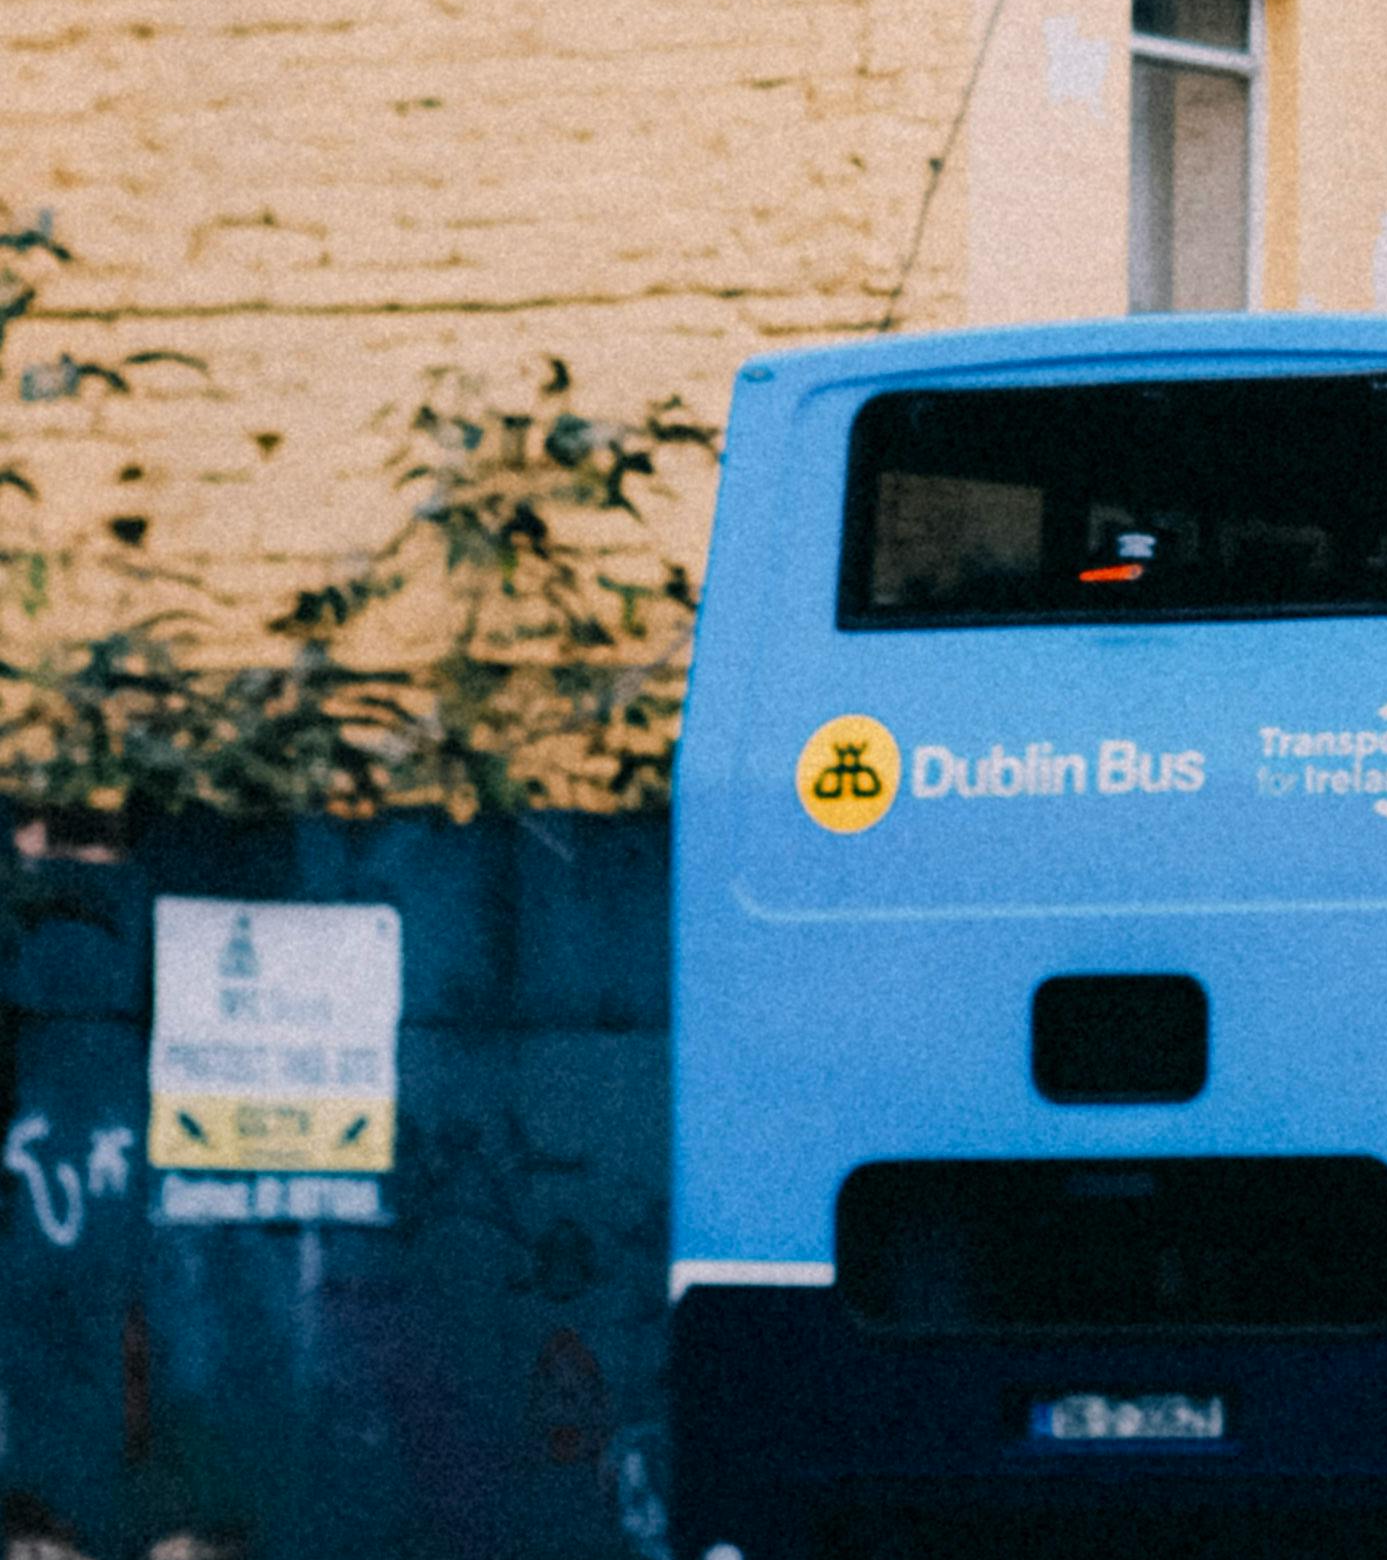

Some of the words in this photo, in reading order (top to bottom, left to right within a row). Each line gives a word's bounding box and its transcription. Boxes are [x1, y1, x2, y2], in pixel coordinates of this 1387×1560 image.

[912, 743, 1088, 800] Dublin
[1098, 739, 1206, 794] Bus
[1256, 765, 1299, 797] for
